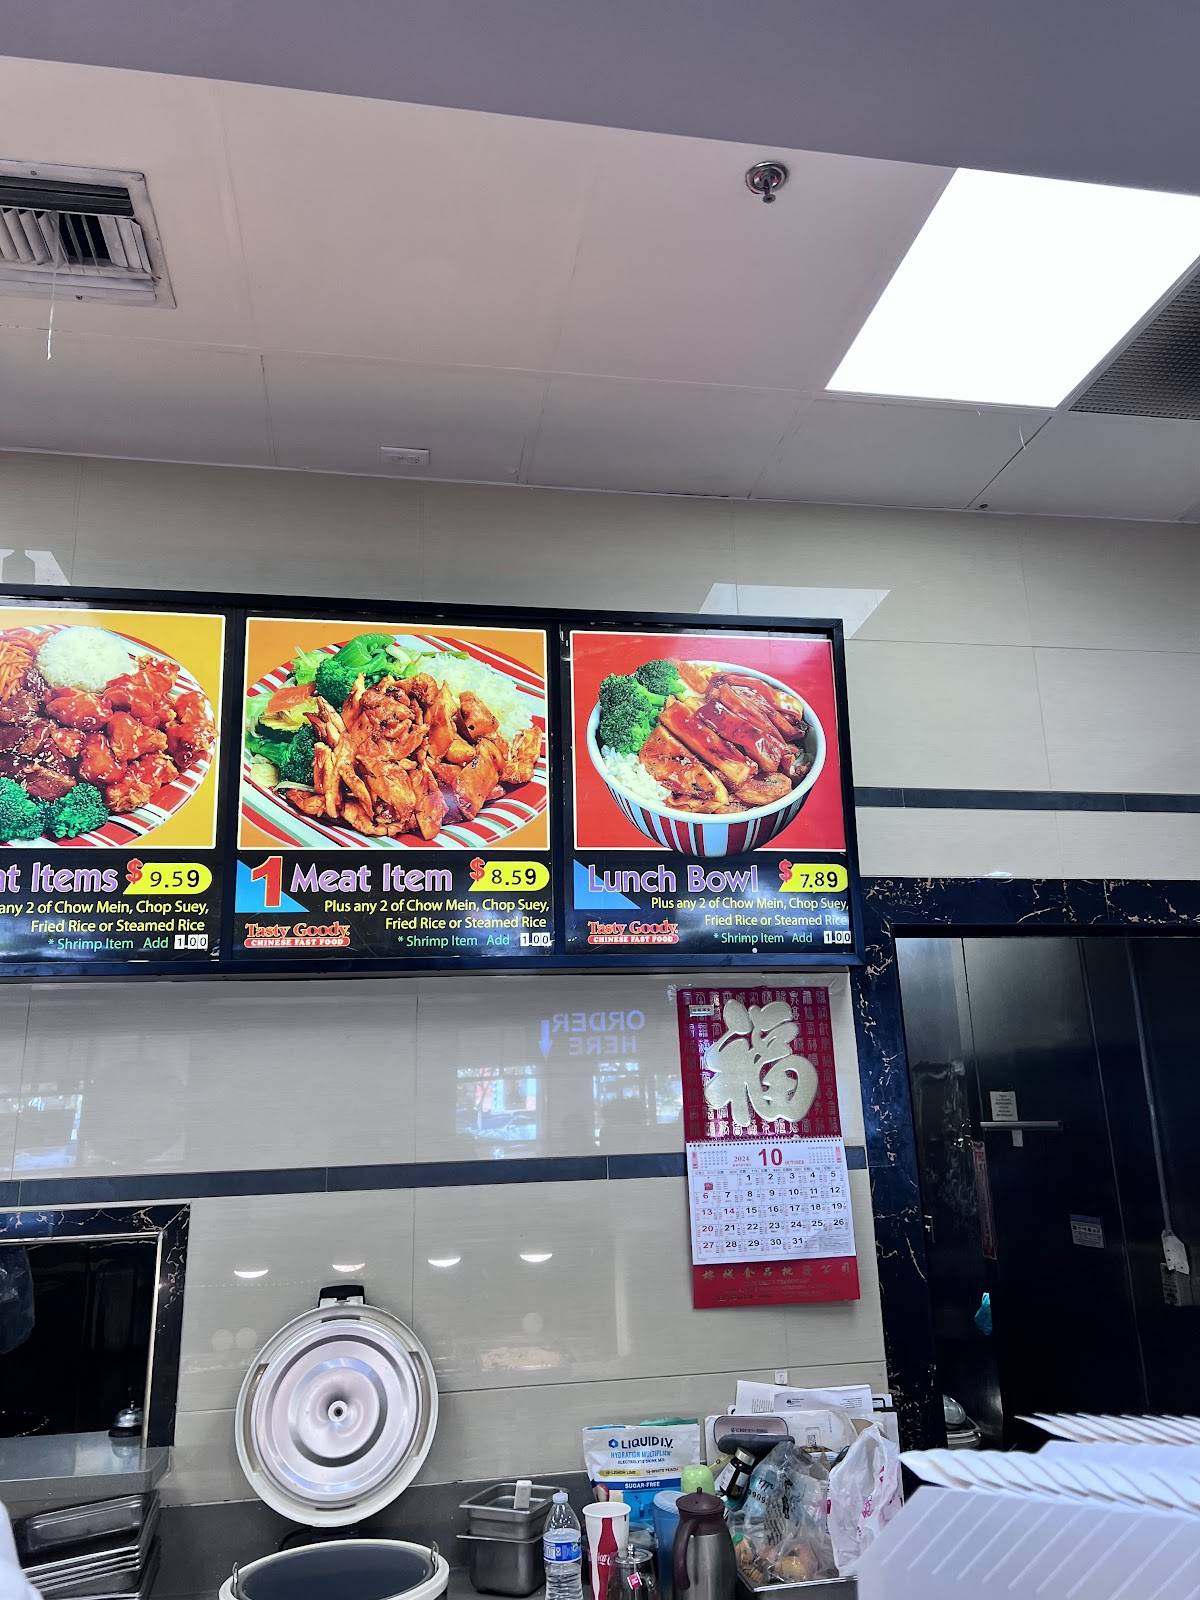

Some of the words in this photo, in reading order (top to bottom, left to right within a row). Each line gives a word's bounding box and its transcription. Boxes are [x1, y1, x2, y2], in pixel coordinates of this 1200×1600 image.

[31, 862, 118, 893] Items
[251, 856, 283, 908] 1
[290, 863, 371, 893] Meat
[382, 862, 453, 892] Item
[588, 864, 677, 893] Lunch
[687, 864, 759, 893] Bowl
[0, 904, 22, 917] any
[26, 902, 34, 914] 2
[38, 901, 53, 913] of
[54, 901, 93, 913] Chow
[96, 901, 133, 915] Mein,
[136, 900, 172, 915] Chop
[175, 900, 209, 915] Suey,
[324, 900, 351, 912] Plus
[353, 902, 377, 915] any
[380, 900, 388, 912] 2
[390, 899, 405, 911] of
[406, 899, 443, 911] Chow
[446, 899, 480, 912] Mein,
[482, 898, 515, 912] Chop
[518, 899, 550, 913] Suey,
[651, 897, 674, 909] Plus
[676, 899, 696, 911] any
[699, 898, 706, 909] 2
[708, 897, 720, 909] of
[722, 897, 753, 909] Chow
[757, 898, 787, 910] Mein,
[789, 898, 818, 911] Chop
[820, 898, 849, 911] Suey,
[31, 920, 65, 932] Fried
[68, 920, 96, 932] Rice
[99, 922, 113, 932] or
[116, 919, 175, 932] Steamed
[178, 919, 205, 931] Rice
[385, 917, 417, 929] Fried
[420, 917, 446, 929] Rice
[449, 919, 462, 929] or
[465, 916, 519, 929] Steamed
[521, 916, 547, 928] Rice
[705, 914, 732, 926] Fried
[735, 915, 758, 926] Rice
[760, 917, 772, 926] or
[774, 914, 822, 926] Steamed
[825, 915, 848, 926] Rice
[245, 923, 291, 939] Tasty
[588, 921, 627, 936] Tasty
[105, 938, 134, 949] Item
[143, 937, 169, 948] Add
[451, 935, 478, 946] Item
[486, 934, 510, 945] Add
[761, 933, 784, 943] Item
[792, 932, 813, 943] Add
[758, 1148, 783, 1166] 10
[789, 1172, 795, 1180] 3
[621, 1436, 660, 1449] LIQUID
[625, 1481, 660, 1489] SUGAR-FREE
